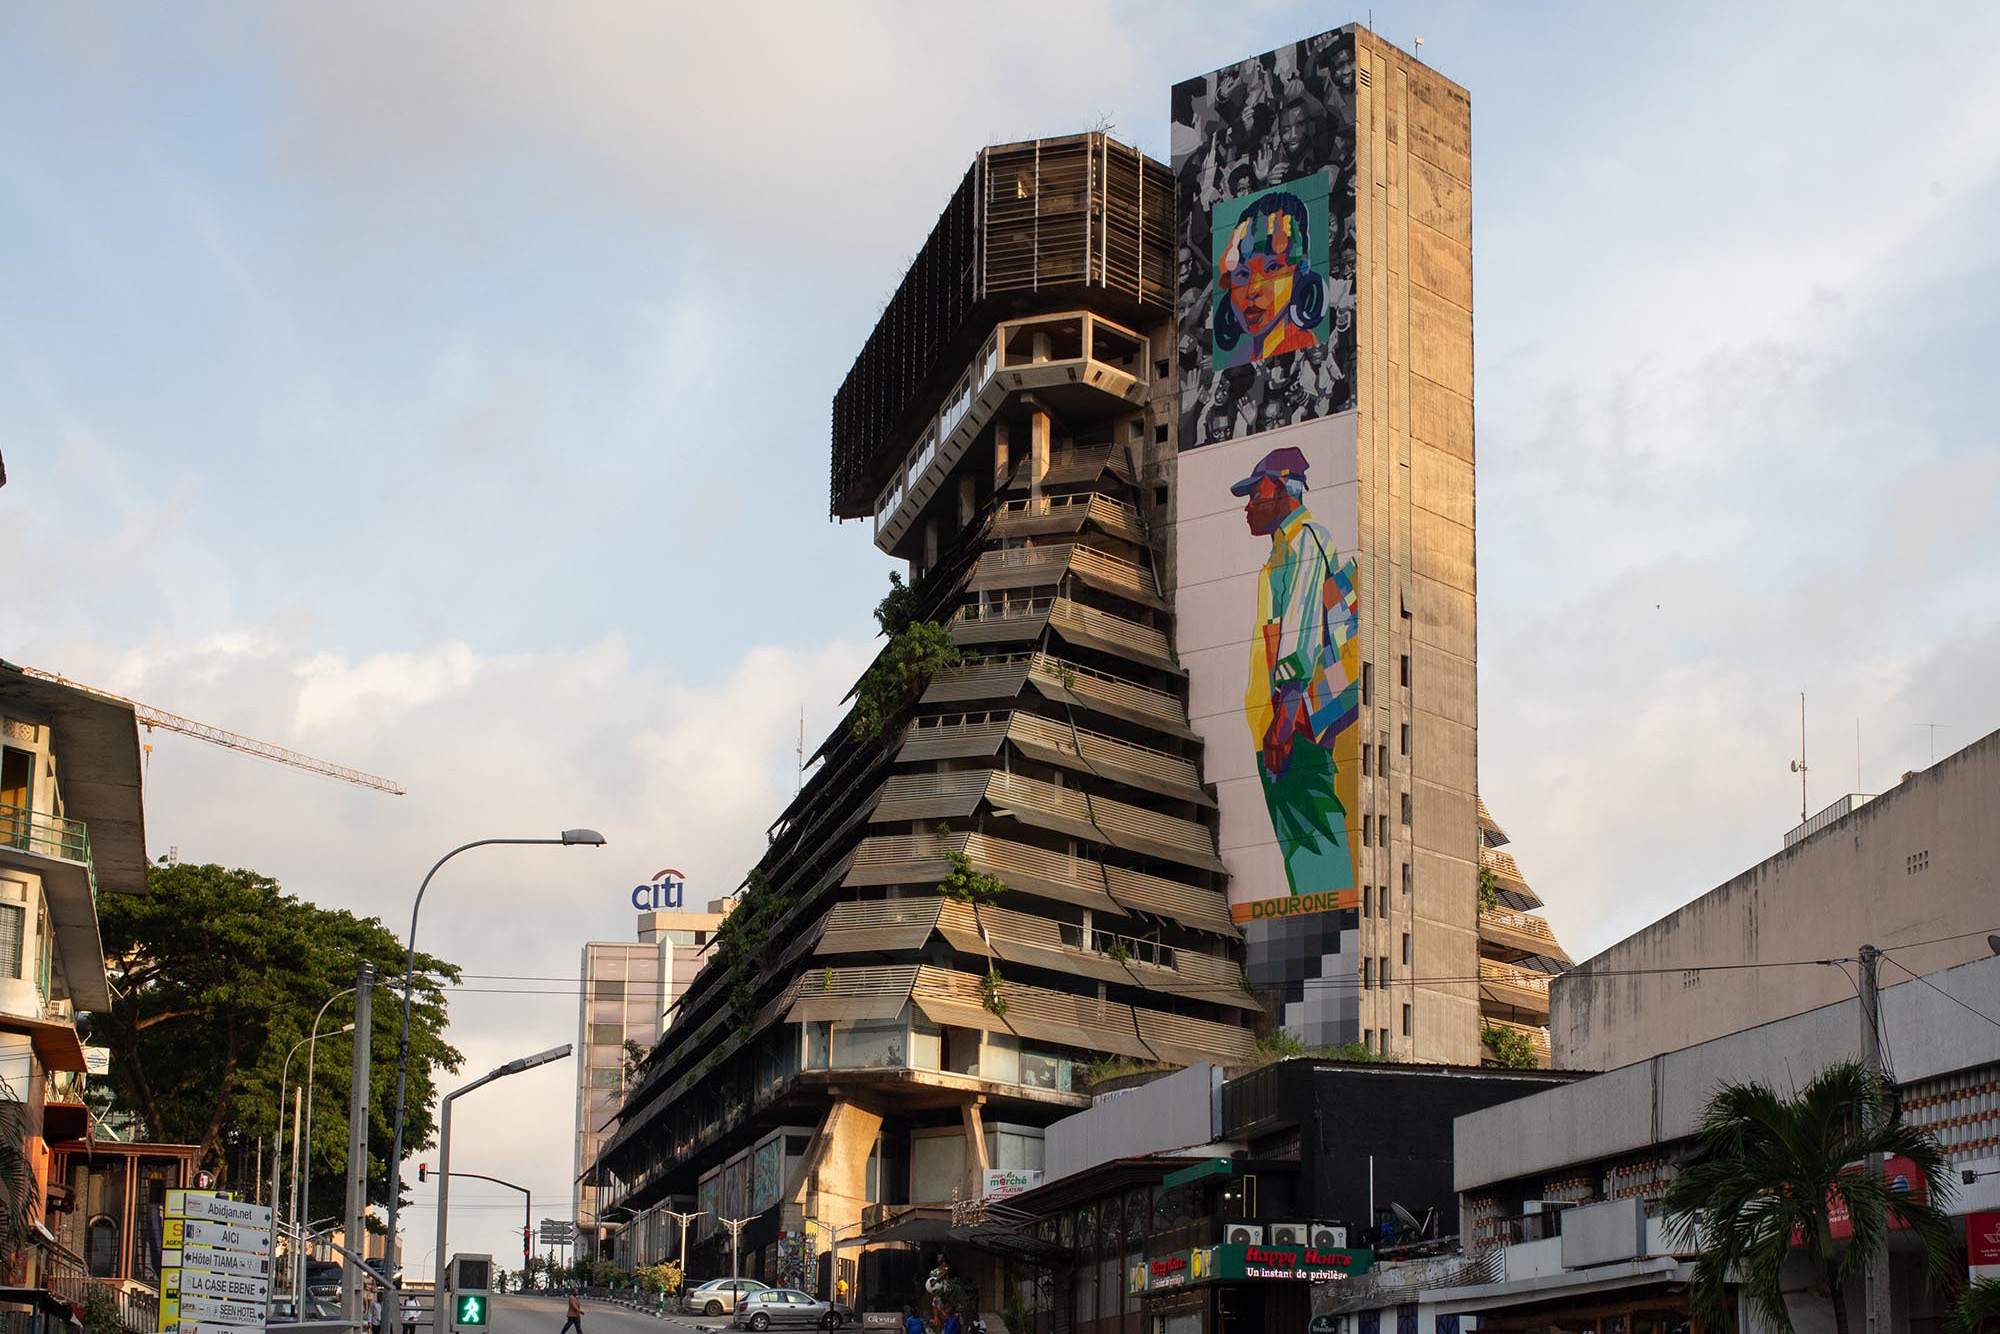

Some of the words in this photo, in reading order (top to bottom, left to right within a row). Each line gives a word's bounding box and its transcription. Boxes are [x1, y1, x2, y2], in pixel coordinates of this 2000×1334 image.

[632, 874, 684, 911] citi
[1252, 892, 1340, 919] DOURONE
[207, 1203, 252, 1219] Abidjan.net
[221, 1230, 240, 1244] AICI
[191, 1251, 212, 1265] Hôtel
[213, 1254, 239, 1269] TIAMA
[1245, 1246, 1297, 1268] Happy
[1303, 1248, 1353, 1266] Hours
[1246, 1267, 1259, 1277] Un
[1261, 1268, 1293, 1279] instant
[1296, 1269, 1307, 1279] de
[192, 1276, 203, 1289] LA
[204, 1278, 228, 1292] CASE
[228, 1281, 256, 1295] EBENE
[219, 1304, 237, 1316] SEEN
[237, 1307, 257, 1319] HOTEL
